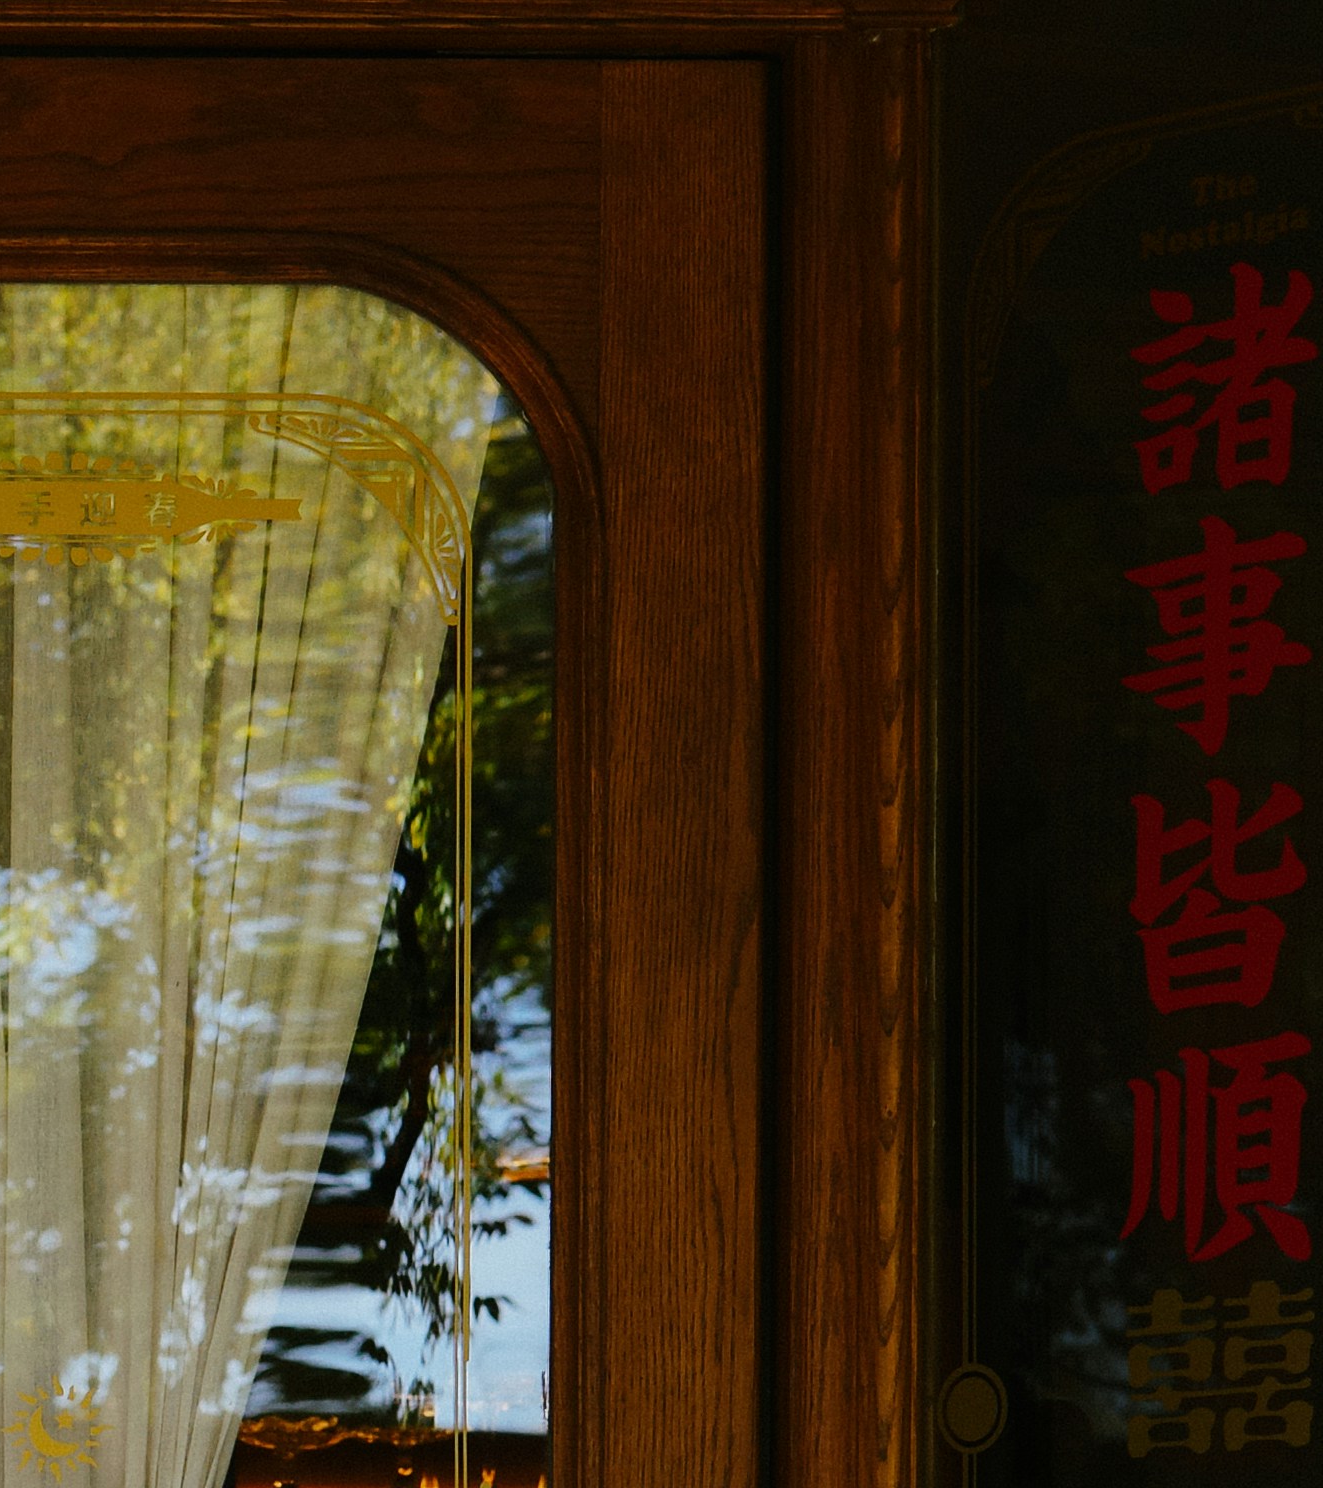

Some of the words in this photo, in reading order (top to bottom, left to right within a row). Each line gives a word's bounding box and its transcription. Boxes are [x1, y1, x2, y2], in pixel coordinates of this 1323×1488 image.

[1188, 173, 1258, 208] The
[1139, 201, 1310, 260] Nostalgia
[1119, 262, 1319, 1263] 諸事皆順
